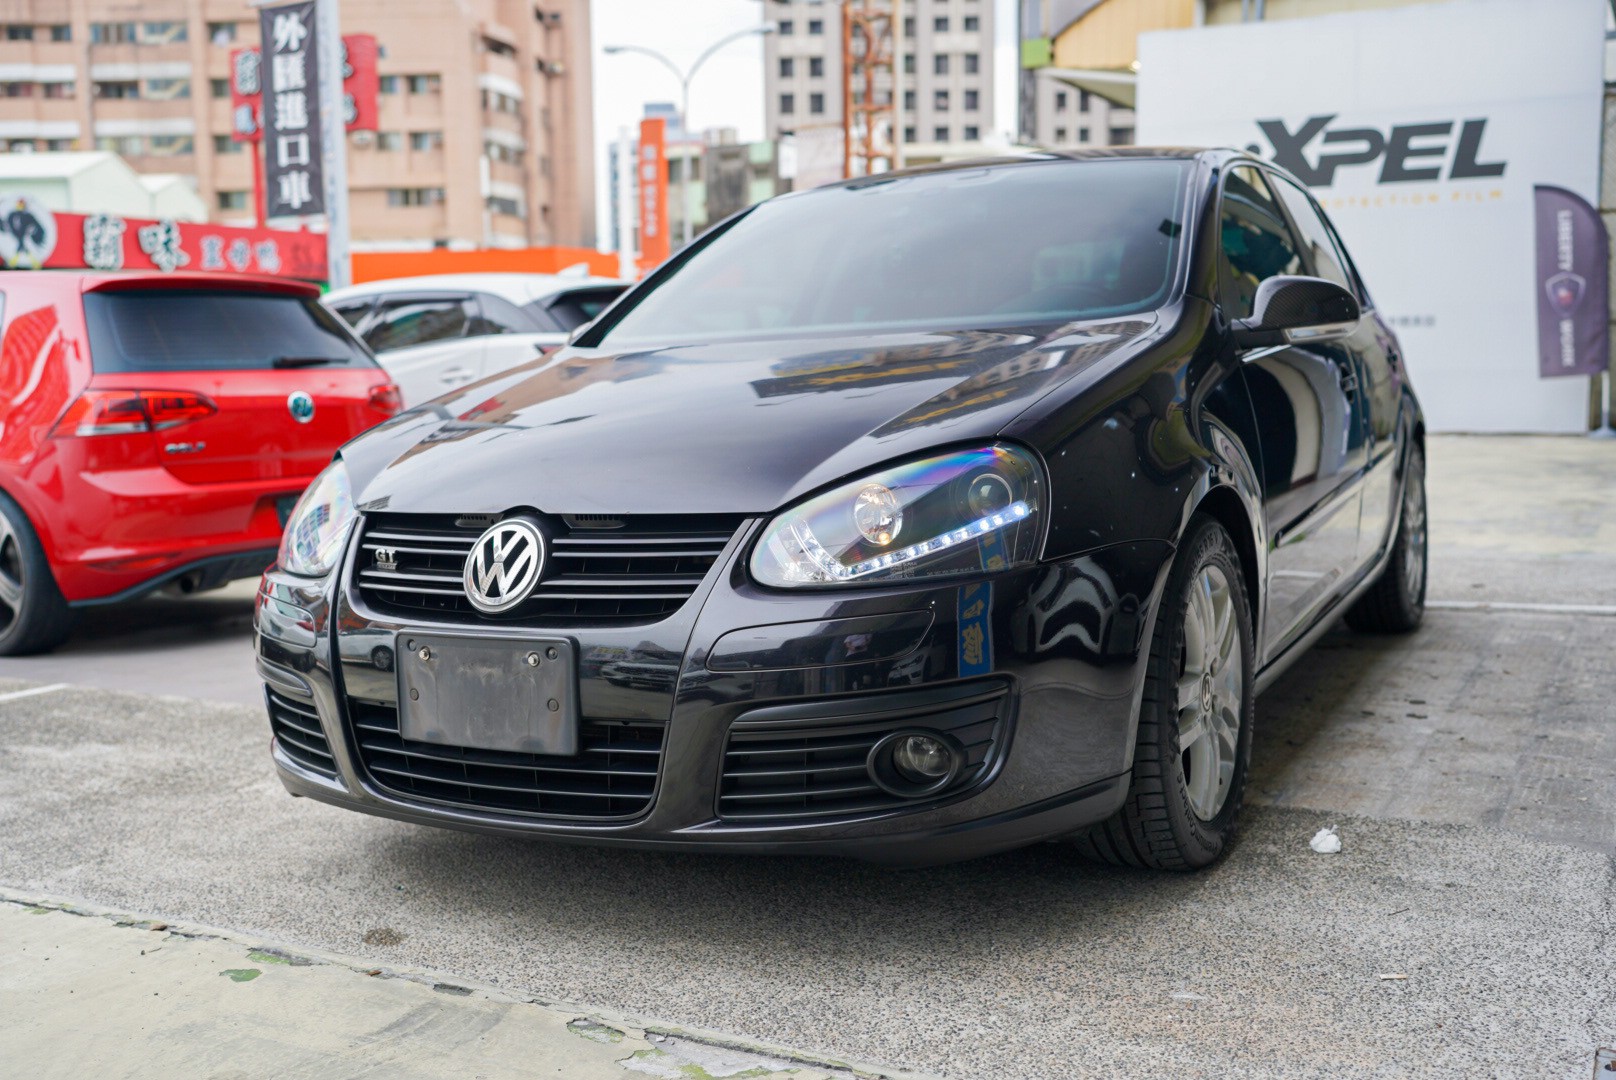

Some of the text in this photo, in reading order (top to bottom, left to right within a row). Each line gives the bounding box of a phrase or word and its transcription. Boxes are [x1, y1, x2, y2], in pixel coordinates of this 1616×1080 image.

[272, 13, 312, 209] 外匯進口車
[1256, 114, 1508, 187] XPEL
[375, 548, 396, 563] GT
